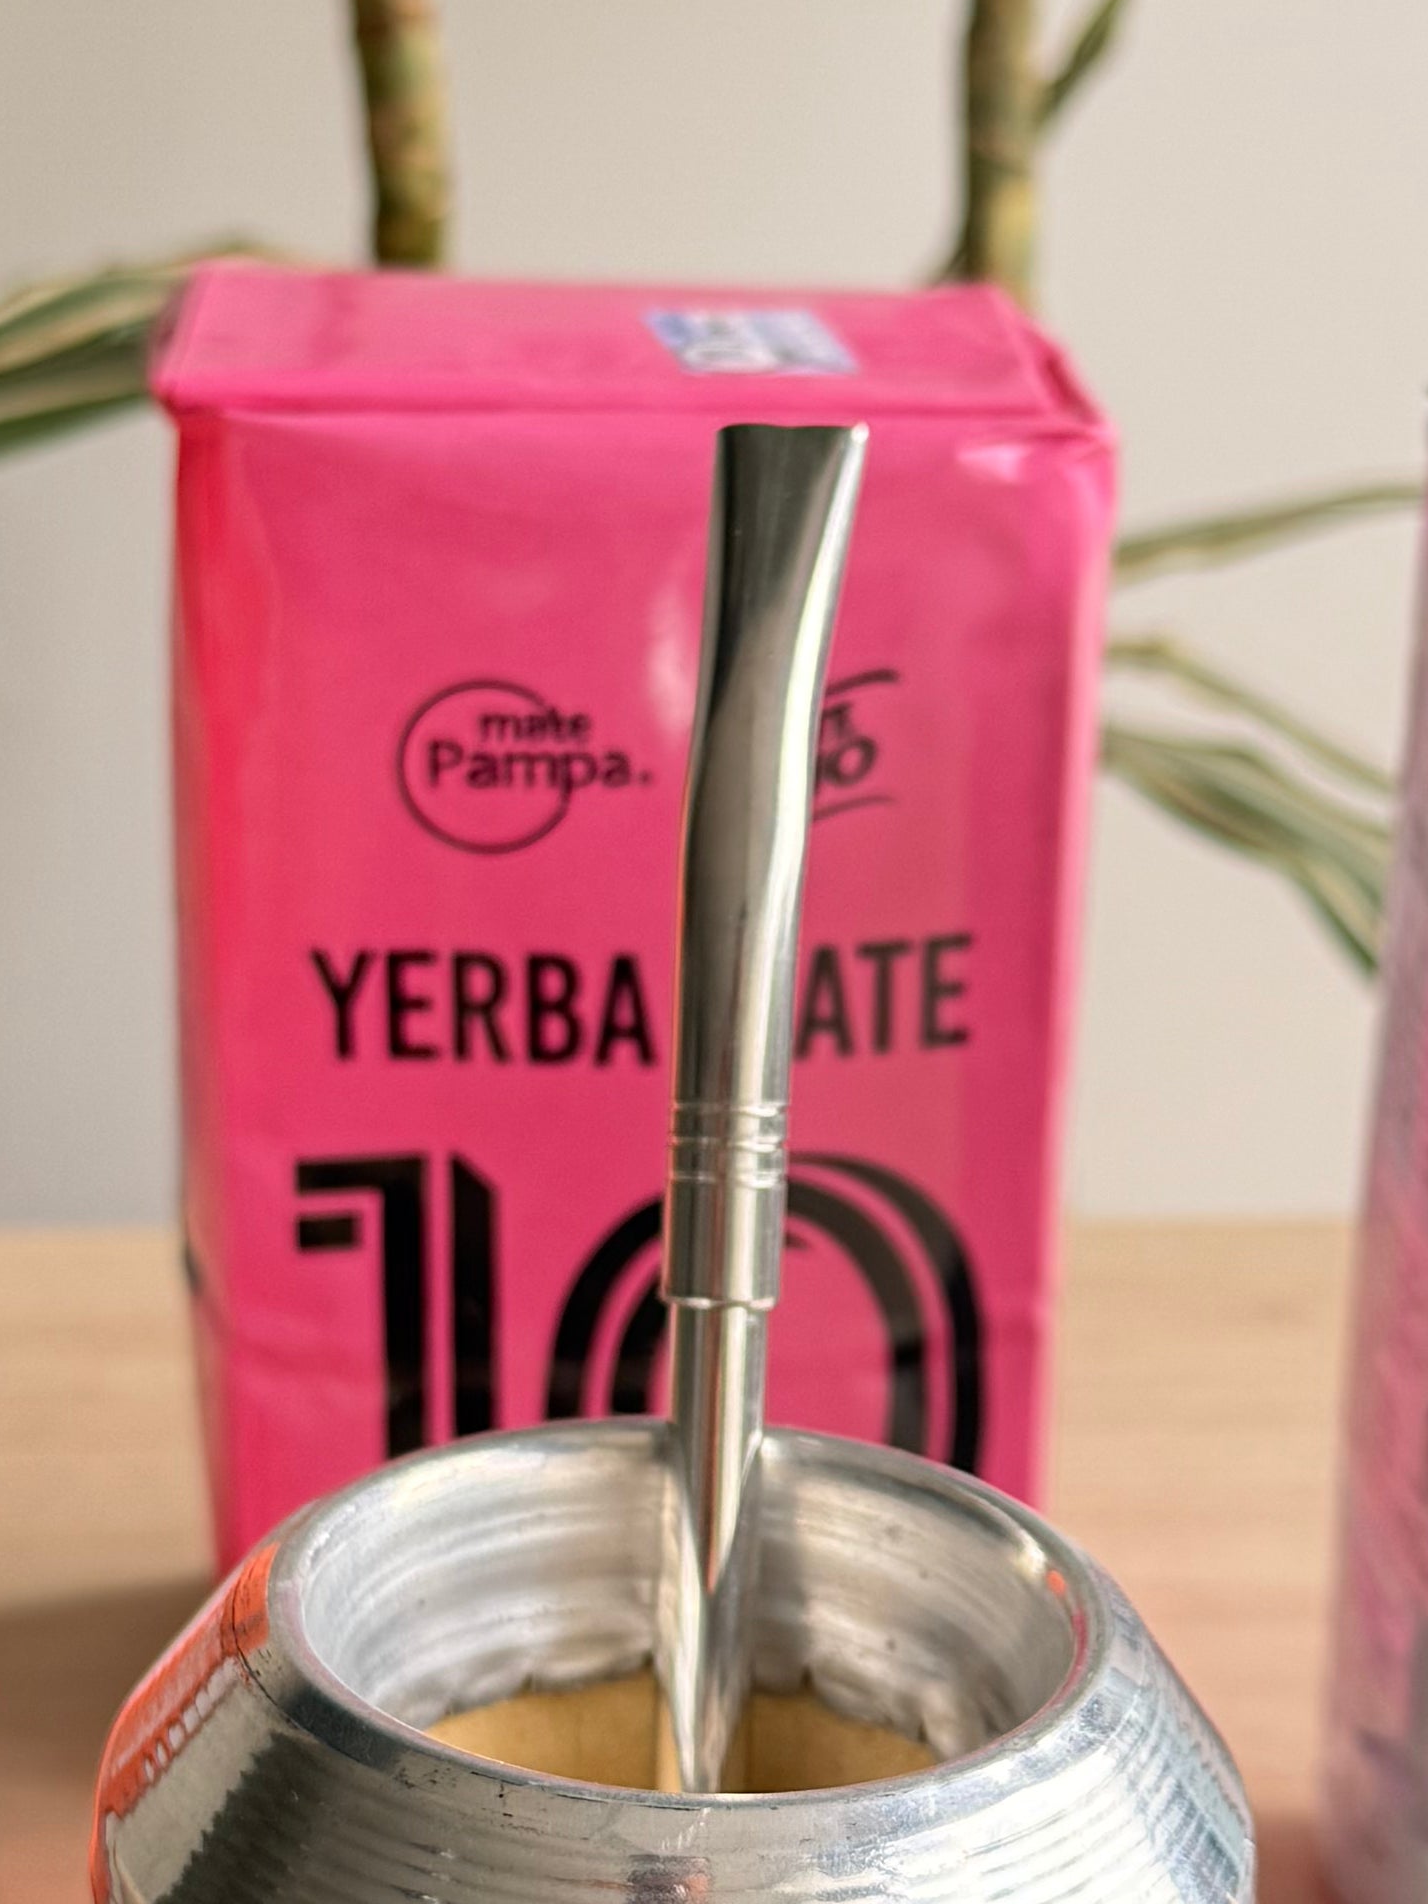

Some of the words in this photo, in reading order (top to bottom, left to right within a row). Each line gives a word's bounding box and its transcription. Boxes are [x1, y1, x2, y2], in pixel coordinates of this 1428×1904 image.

[479, 704, 591, 744] mate
[310, 946, 655, 1066] YERBA
[793, 932, 974, 1060] ATE
